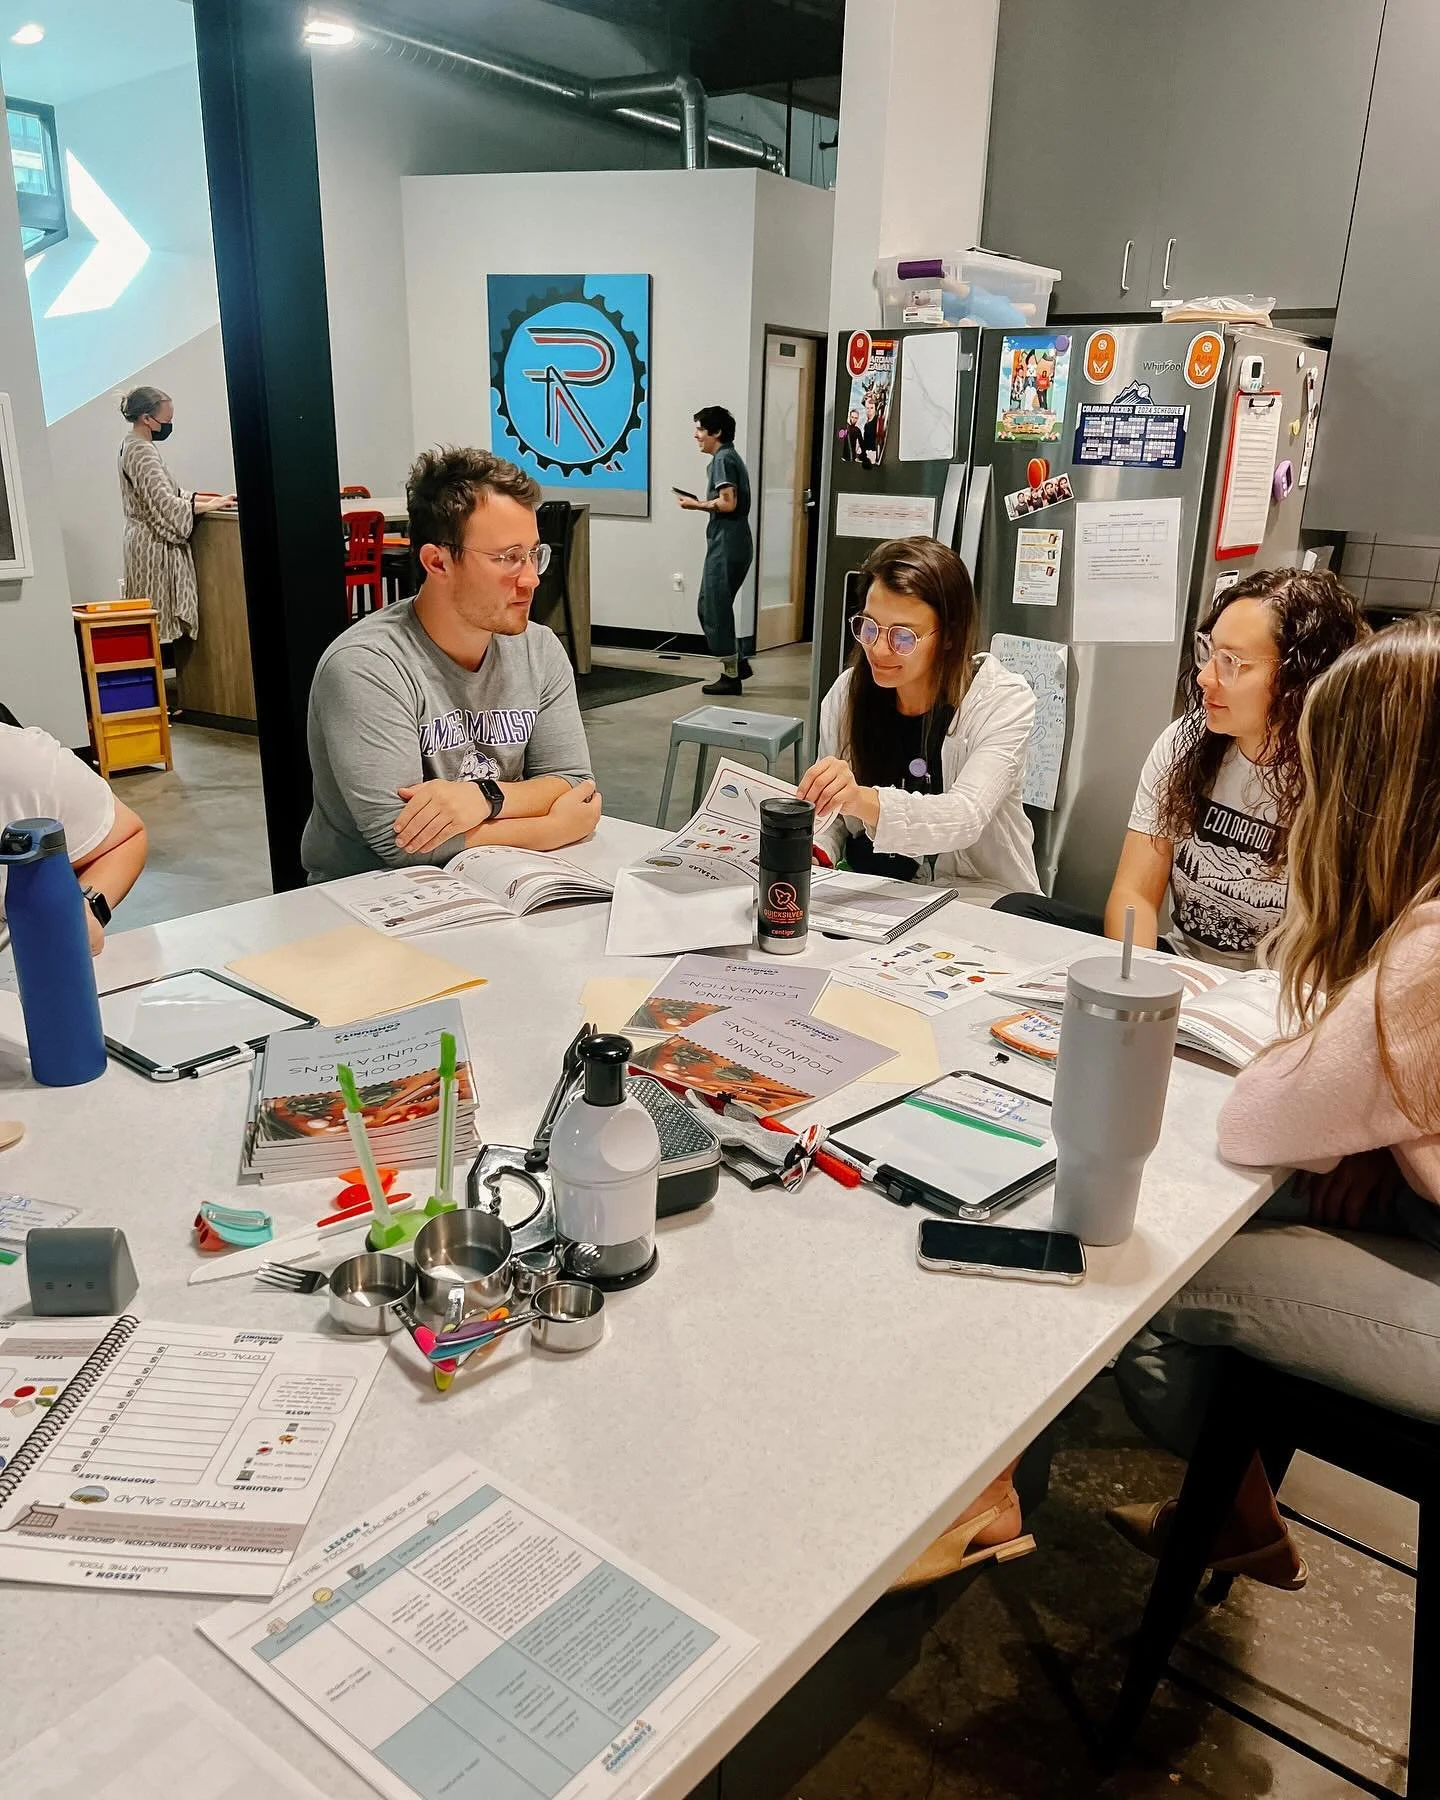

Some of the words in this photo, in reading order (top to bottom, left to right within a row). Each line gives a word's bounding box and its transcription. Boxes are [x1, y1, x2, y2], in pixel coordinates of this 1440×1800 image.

[1082, 405, 1109, 413] COLORADO
[1110, 406, 1133, 414] ROCKIES
[465, 709, 539, 746] MADISO
[1203, 806, 1276, 852] COLORADO
[688, 863, 711, 877] SALAD
[764, 908, 804, 919] QUICKSILVER
[680, 979, 799, 999] FOUNDATIONS
[335, 1022, 401, 1040] COMMUNITY
[724, 1019, 833, 1075] FOUNDATIONS
[726, 1038, 797, 1075] COOKING
[193, 1350, 226, 1359] COST
[231, 1353, 267, 1361] TOTAL
[79, 1472, 101, 1480] LIST
[103, 1475, 156, 1485] SHOPPING
[114, 1494, 164, 1506] SALAD
[170, 1497, 245, 1511] TEXTURED
[17, 1530, 65, 1540] SHOPPING
[69, 1534, 115, 1544] GROCERY
[124, 1539, 188, 1548] INSTRUCTION
[324, 1527, 361, 1554] LESSON
[189, 1543, 222, 1551] BASED
[224, 1545, 284, 1553] COMMUNITY
[67, 1560, 105, 1569] TOOLS
[108, 1562, 128, 1571] THE
[130, 1563, 168, 1573] LEARN
[96, 1571, 141, 1580] LESSON
